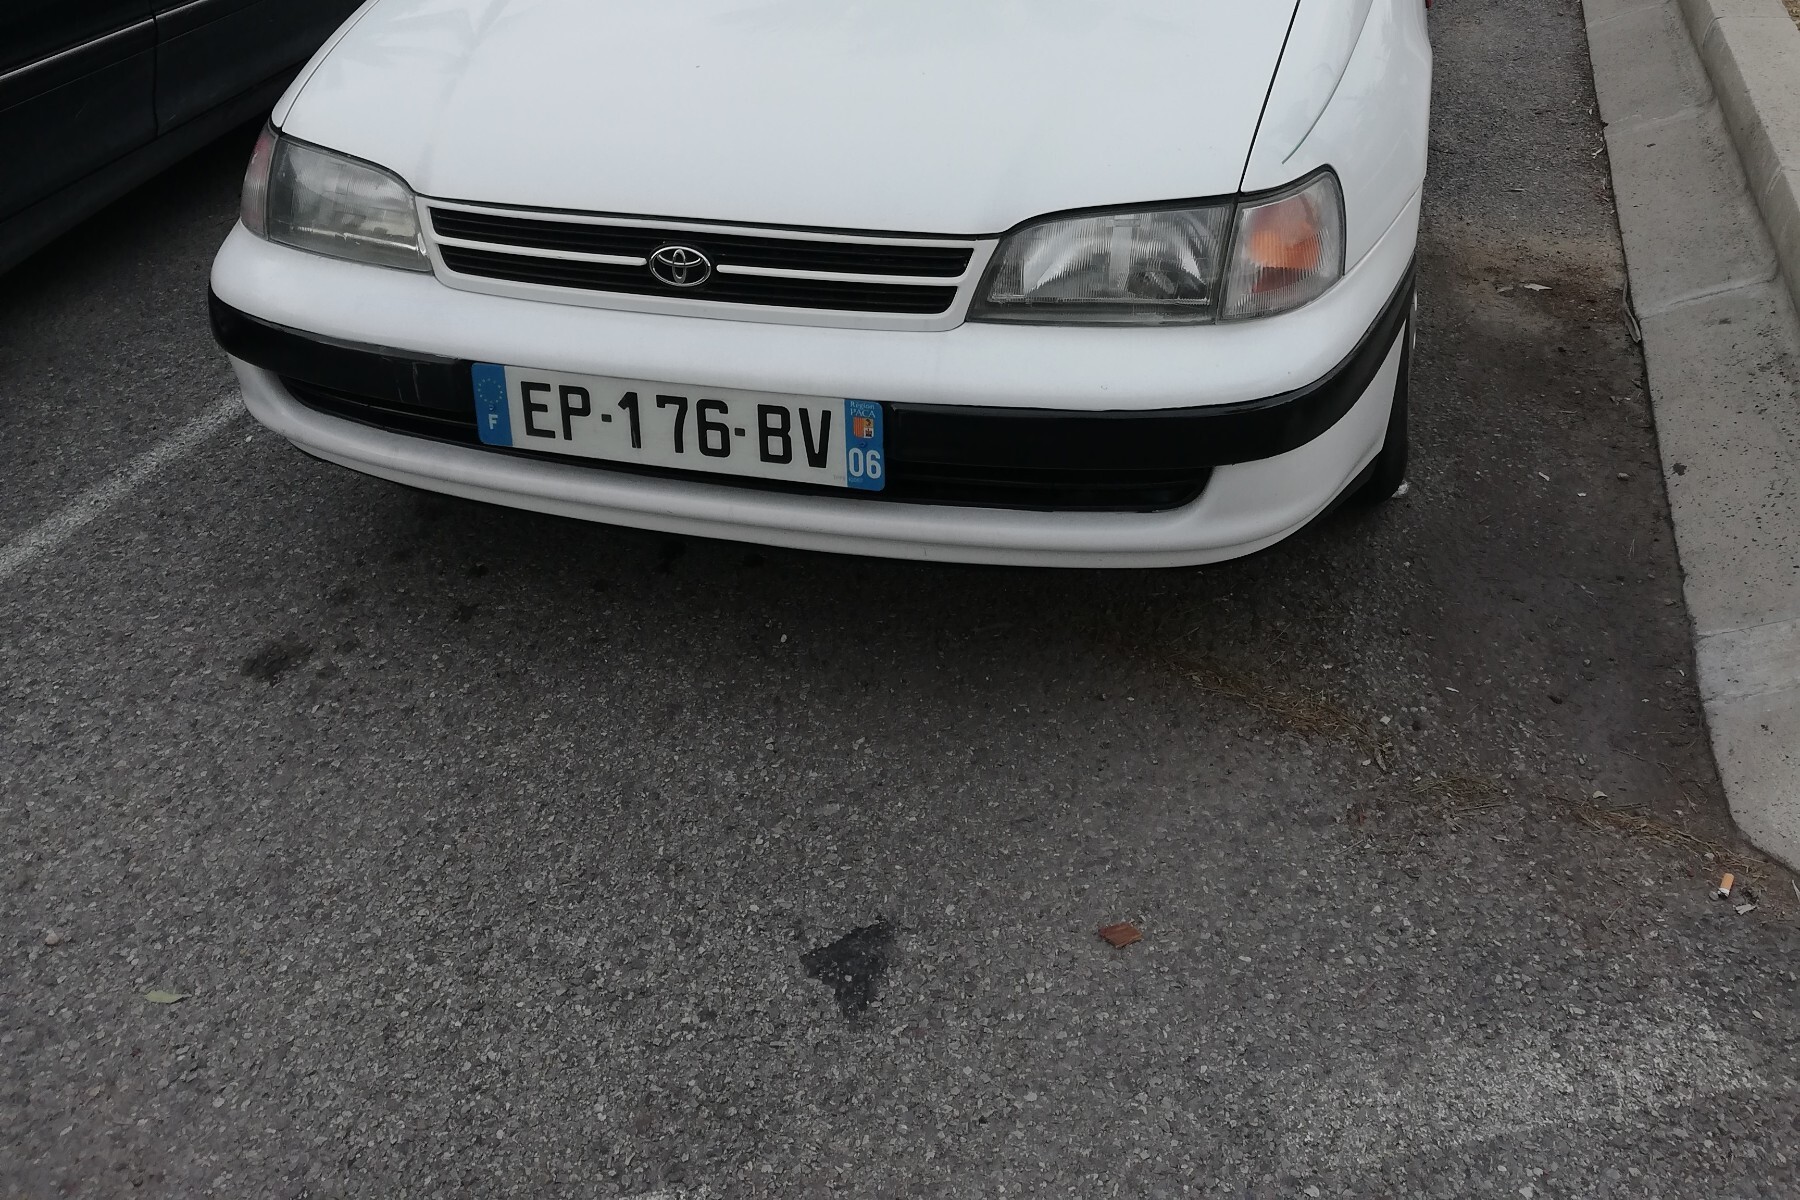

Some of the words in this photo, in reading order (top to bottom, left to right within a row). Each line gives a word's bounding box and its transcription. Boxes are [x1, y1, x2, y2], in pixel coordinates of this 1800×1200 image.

[488, 413, 498, 430] F
[520, 381, 832, 469] EP-176-BV
[850, 408, 876, 418] PACA
[848, 447, 882, 479] 06
